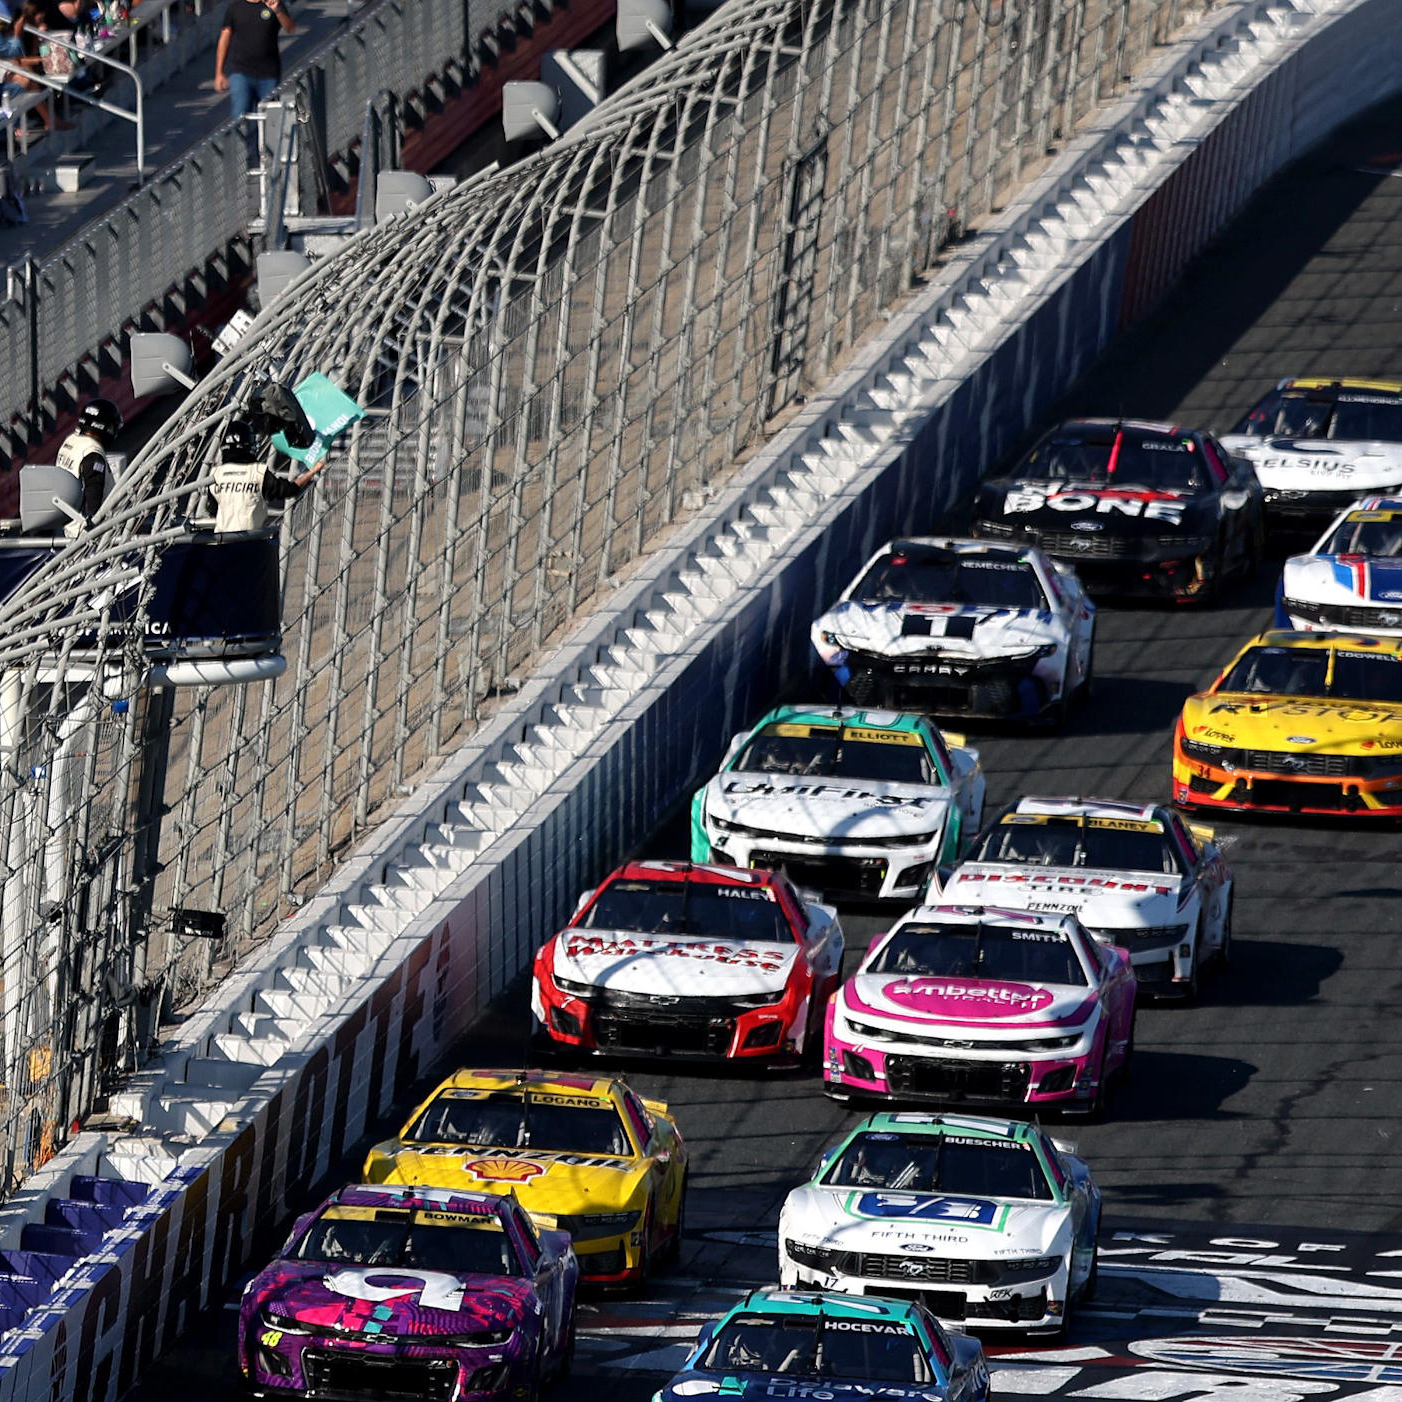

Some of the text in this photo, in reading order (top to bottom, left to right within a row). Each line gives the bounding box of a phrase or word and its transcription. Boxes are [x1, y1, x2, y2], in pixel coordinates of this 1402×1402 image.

[1004, 490, 1187, 526] BONE
[894, 666, 969, 677] CAMRY
[850, 732, 910, 742] ELLIOTT
[958, 874, 1173, 897] DISCOUNT
[717, 888, 772, 901] HALEY
[1027, 902, 1084, 914] PENNZOIL
[1011, 931, 1065, 943] SMITH
[533, 1094, 601, 1108] LOGANO
[945, 1136, 1022, 1150] BUESCHER
[424, 1212, 492, 1225] BOWMAN
[871, 1231, 969, 1243] FIFTH THIRD
[824, 1277, 839, 1288] 17
[824, 1320, 910, 1337] HOCEVAR
[260, 1331, 283, 1348] 48
[766, 1386, 835, 1401] Life
